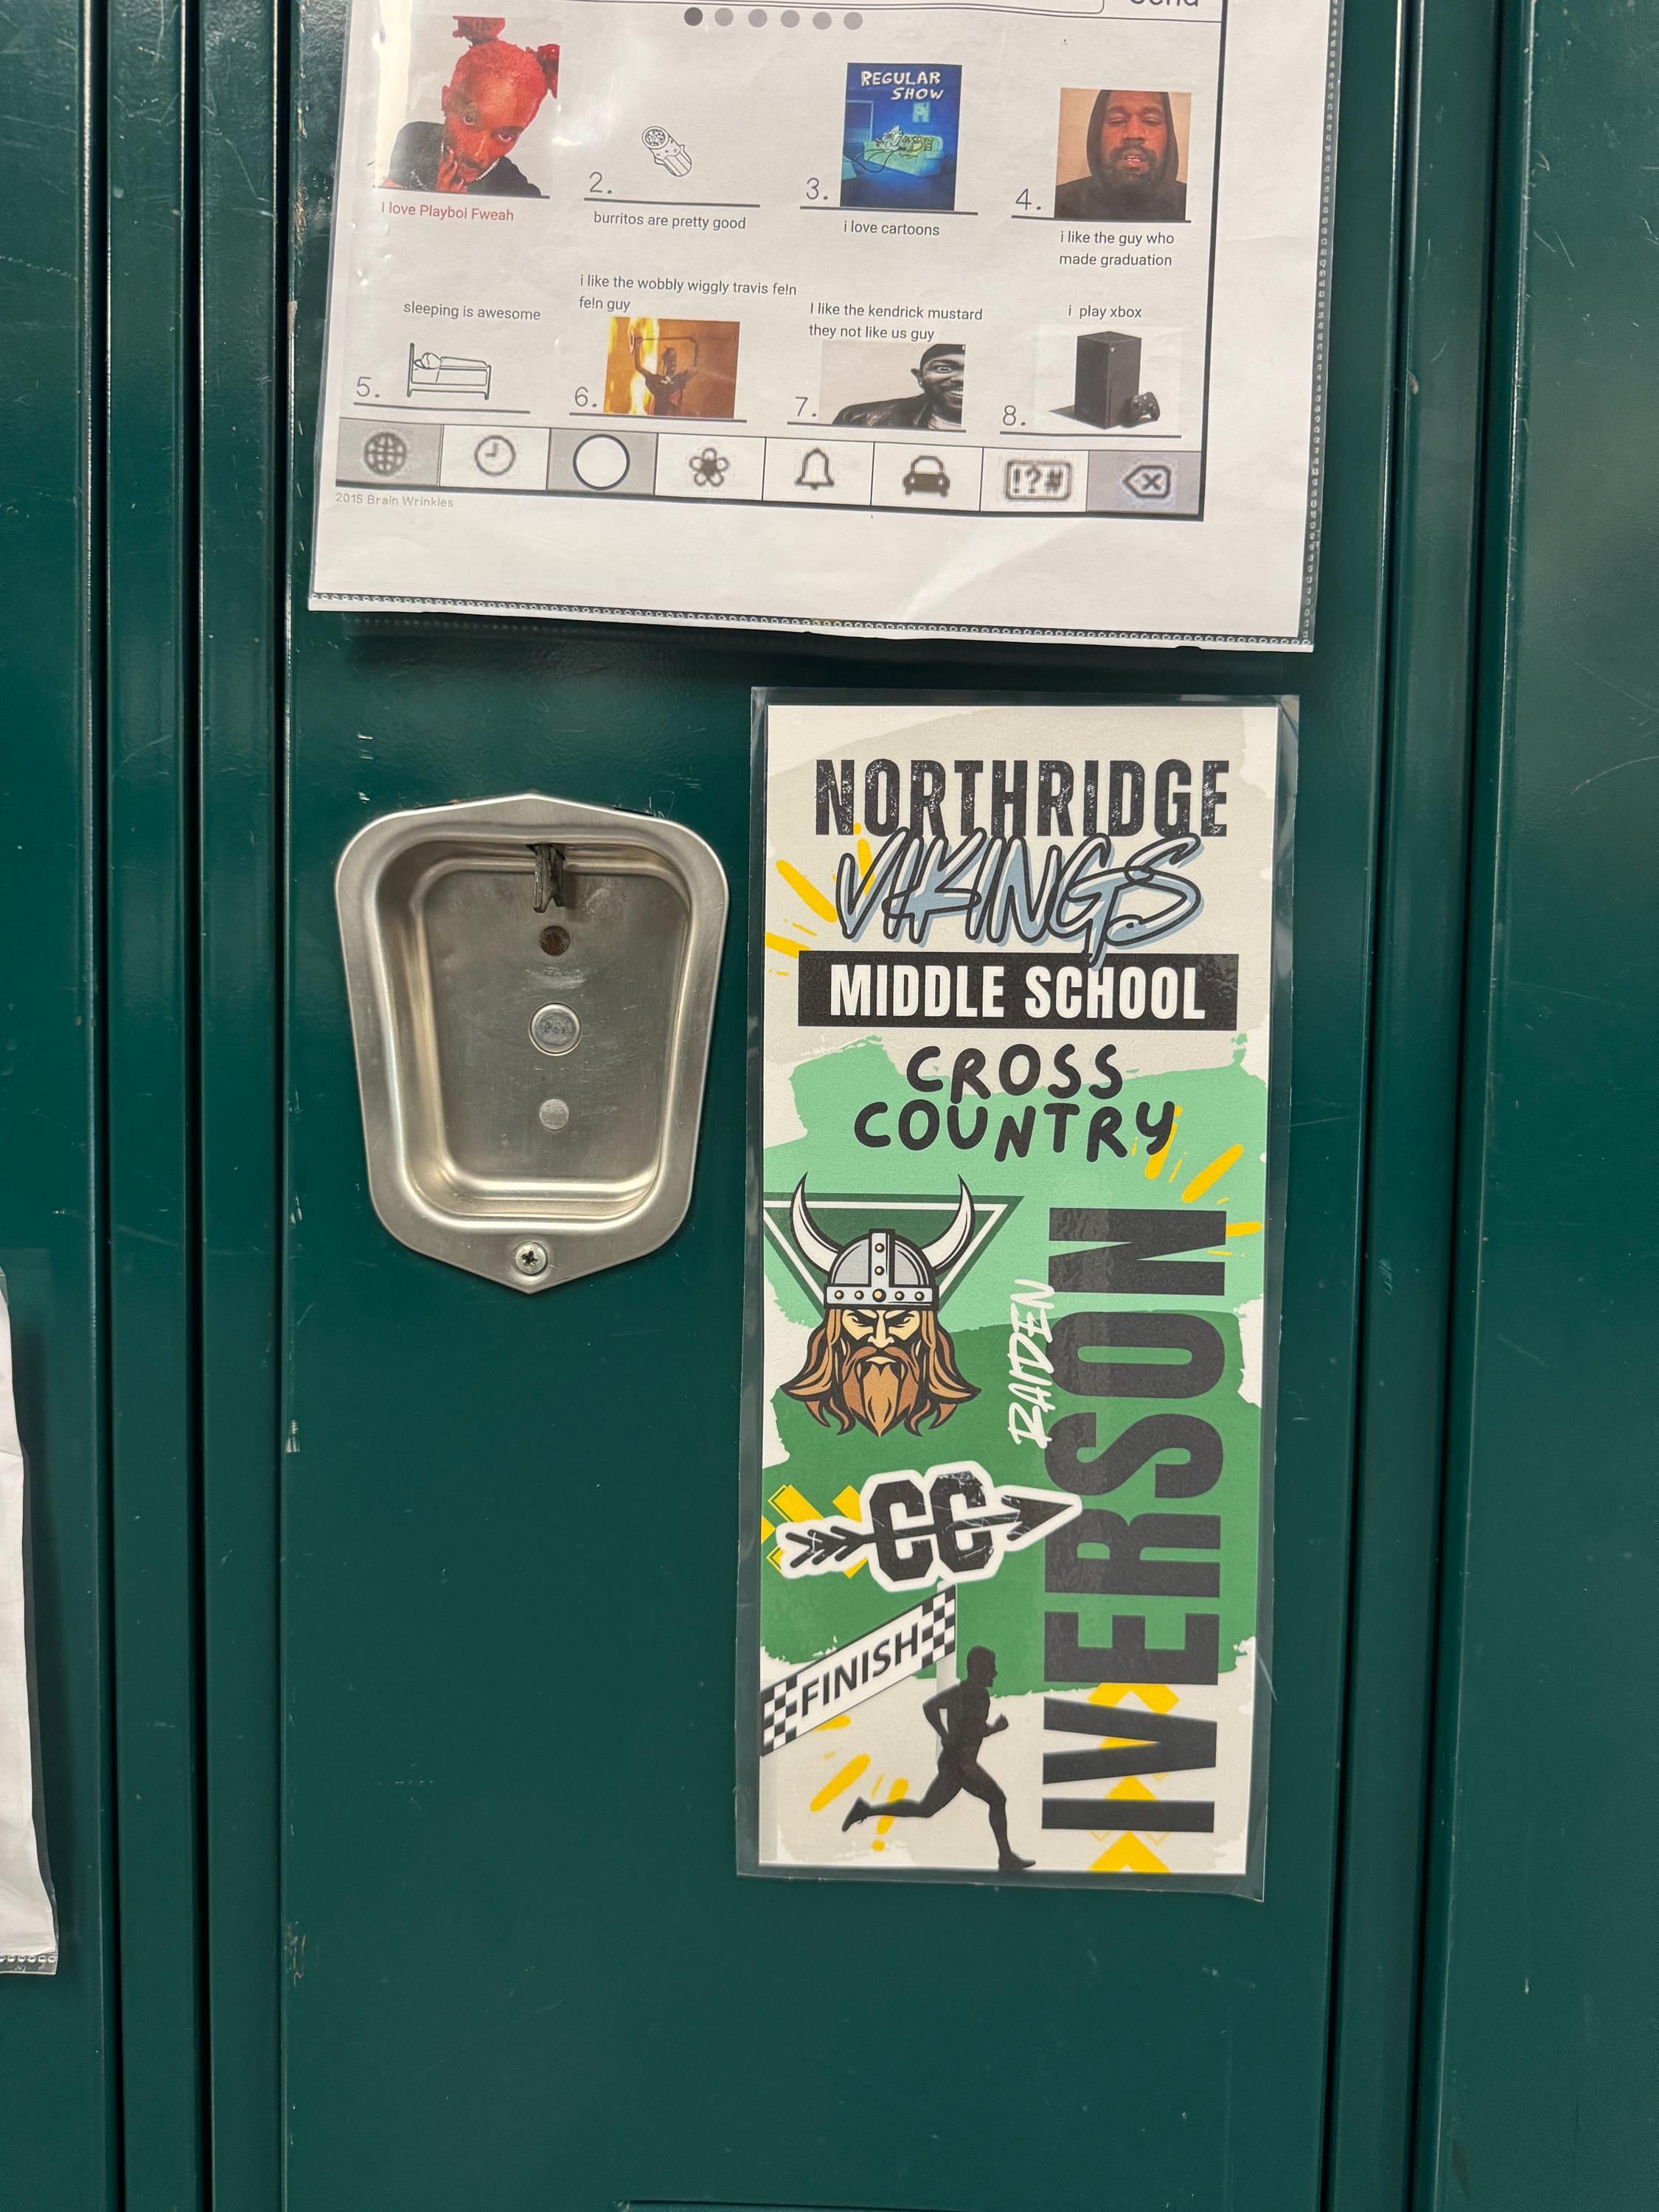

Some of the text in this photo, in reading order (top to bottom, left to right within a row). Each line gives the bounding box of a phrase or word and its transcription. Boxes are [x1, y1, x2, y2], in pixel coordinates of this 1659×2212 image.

[860, 69, 941, 87] REGULAR
[889, 87, 944, 100] SHOW
[381, 201, 514, 221] I love Playboi Fweah
[594, 210, 746, 232] burritos are pretty good
[844, 220, 939, 236] i love cartoons
[1060, 230, 1175, 247] i like the guy who
[1059, 253, 1172, 268] made graduation
[580, 274, 796, 296] i like the wobbly wiggly travis fe!n
[403, 301, 541, 321] sleeping is awesome
[579, 296, 630, 313] fe!n guy
[810, 302, 983, 320] I like the kendrick mustard
[1068, 305, 1142, 320] i play xbox
[809, 324, 935, 344] they not like us guy
[335, 492, 453, 507] 2015 Brain Wrinkles
[815, 759, 1229, 837] NORTHRIDGE
[836, 827, 1203, 970] VIKINGS
[830, 964, 1205, 1020] MIDDLE SCHOOL
[906, 1044, 1122, 1104] CROSS
[854, 1099, 1176, 1162] COUNTRY
[1008, 1279, 1055, 1448] RAIDEN
[1042, 1207, 1227, 1833] IVERSON
[801, 1622, 918, 1717] FINISH
